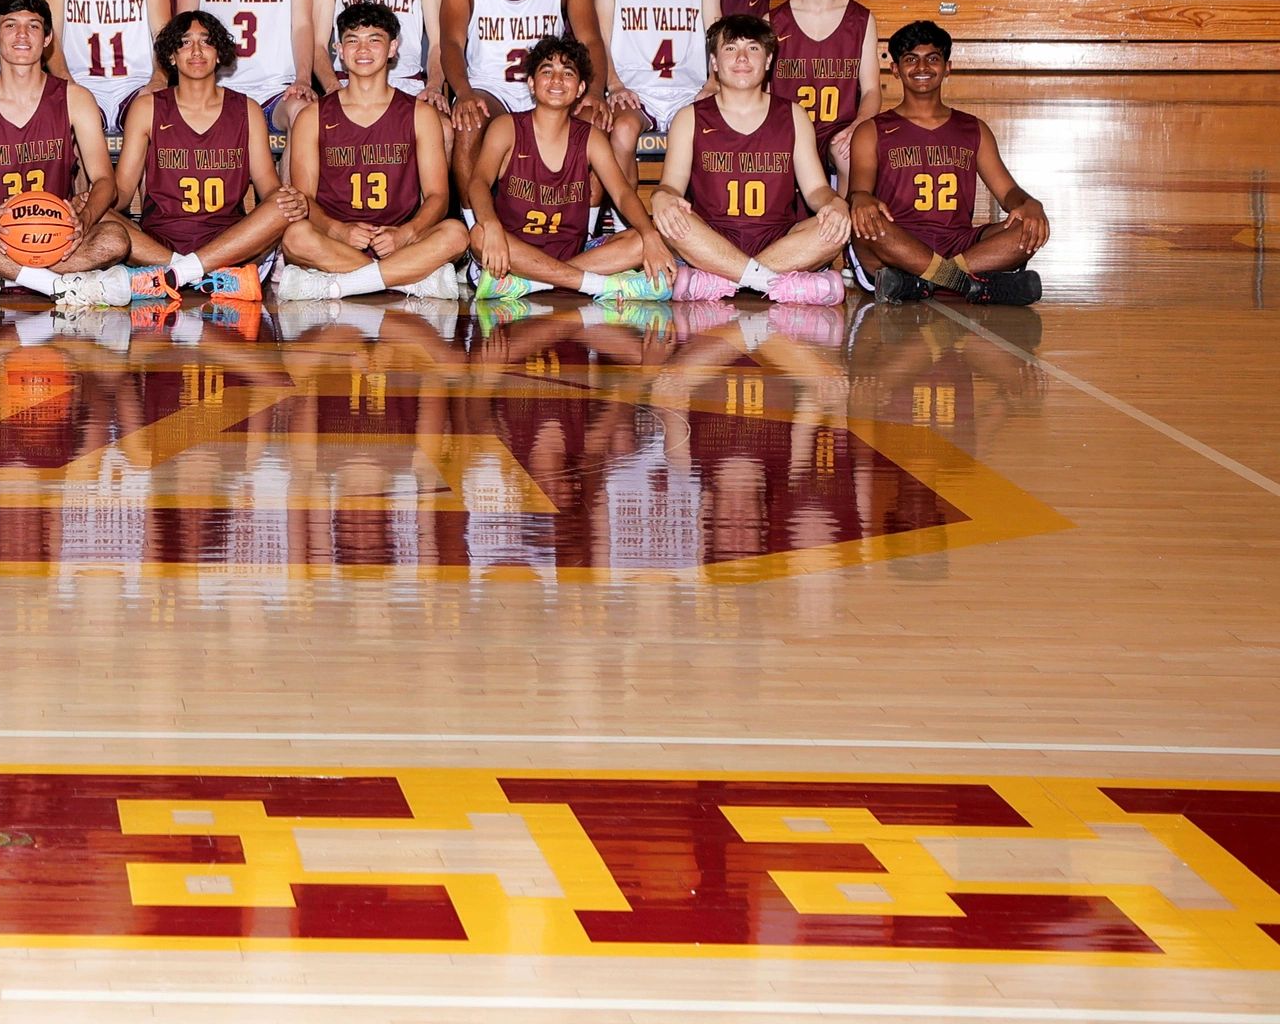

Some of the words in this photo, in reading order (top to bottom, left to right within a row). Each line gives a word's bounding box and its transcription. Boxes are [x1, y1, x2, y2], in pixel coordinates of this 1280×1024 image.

[67, 0, 92, 23] SIMI
[621, 6, 648, 32] SIMI
[652, 7, 699, 33] VALLEY
[234, 12, 258, 58] 3
[478, 16, 504, 41] SIMI
[509, 15, 558, 41] VALLEY
[88, 32, 128, 77] 11
[651, 39, 677, 78] 4
[776, 58, 808, 79] SIMI
[812, 57, 861, 79] VALLEY
[797, 86, 840, 122] 20
[15, 139, 64, 163] VALLEY
[157, 149, 187, 169] SIMI
[191, 148, 244, 170] VALLEY
[325, 144, 357, 165] SIMI
[360, 143, 410, 164] VALLEY
[702, 151, 735, 172] SIMI
[739, 151, 790, 174] VALLEY
[887, 146, 921, 169] SIMI
[925, 145, 974, 171] VALLEY
[178, 177, 225, 213] 30
[350, 171, 388, 209] 13
[507, 176, 536, 203] SIMI
[539, 180, 584, 206] VALLEY
[726, 180, 766, 217] 10
[913, 173, 958, 212] 32
[12, 204, 63, 220] Wilson
[522, 210, 563, 234] 21
